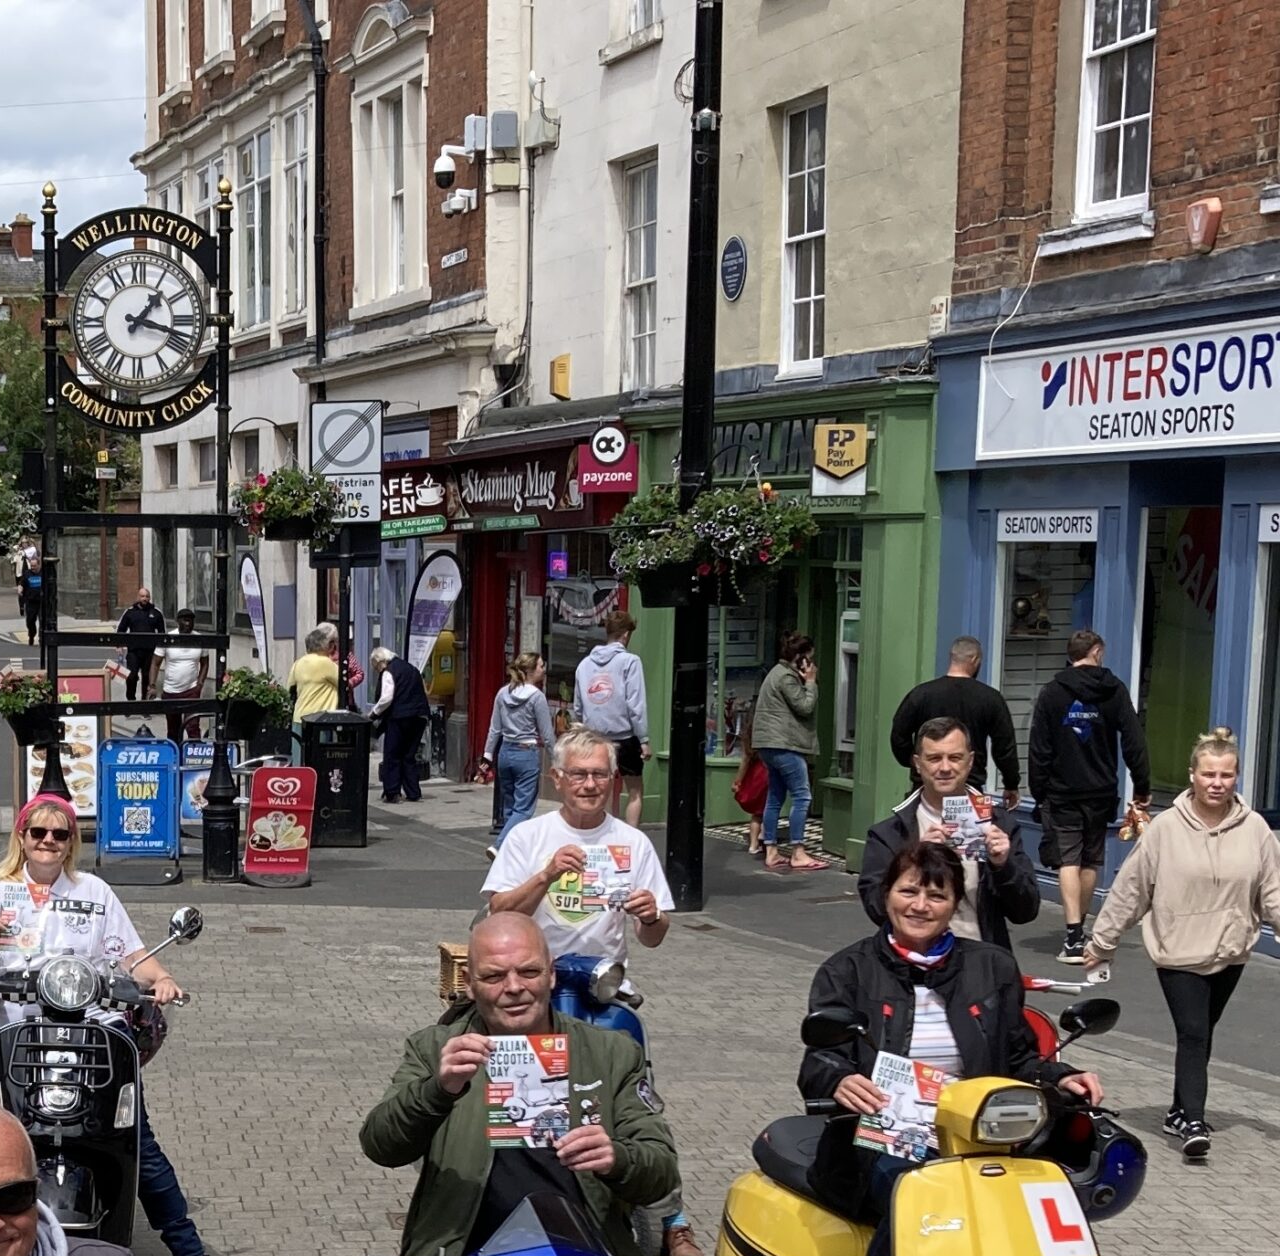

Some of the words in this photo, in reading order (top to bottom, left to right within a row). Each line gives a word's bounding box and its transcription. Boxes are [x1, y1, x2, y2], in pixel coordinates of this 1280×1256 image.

[72, 213, 203, 251] WELLINGTON
[1069, 333, 1280, 407] INTERSPOR
[61, 382, 156, 427] COMMUNITY
[162, 380, 213, 422] CLOCK
[1089, 409, 1157, 440] SEATON
[1161, 403, 1235, 435] SPORTS
[827, 448, 846, 458] Pay
[827, 458, 854, 467] Point
[583, 471, 632, 485] payzone
[466, 466, 523, 513] Steaming
[524, 461, 556, 510] Mug
[404, 517, 440, 526] TAKEAWAY
[1005, 518, 1046, 534] SEATON
[1049, 516, 1093, 534] SPORTS
[116, 751, 160, 765] STAR
[115, 772, 159, 782] SUBSCRIBE
[116, 782, 159, 799] TODAY
[267, 797, 298, 805] WALL'S
[555, 895, 580, 909] SUP
[489, 1053, 536, 1065] SCOOTER
[880, 1056, 913, 1074] ITALIAN
[490, 1066, 510, 1078] DAY
[877, 1066, 915, 1087] SCOOTER
[875, 1078, 892, 1090] DAY
[1040, 1198, 1084, 1242] L
